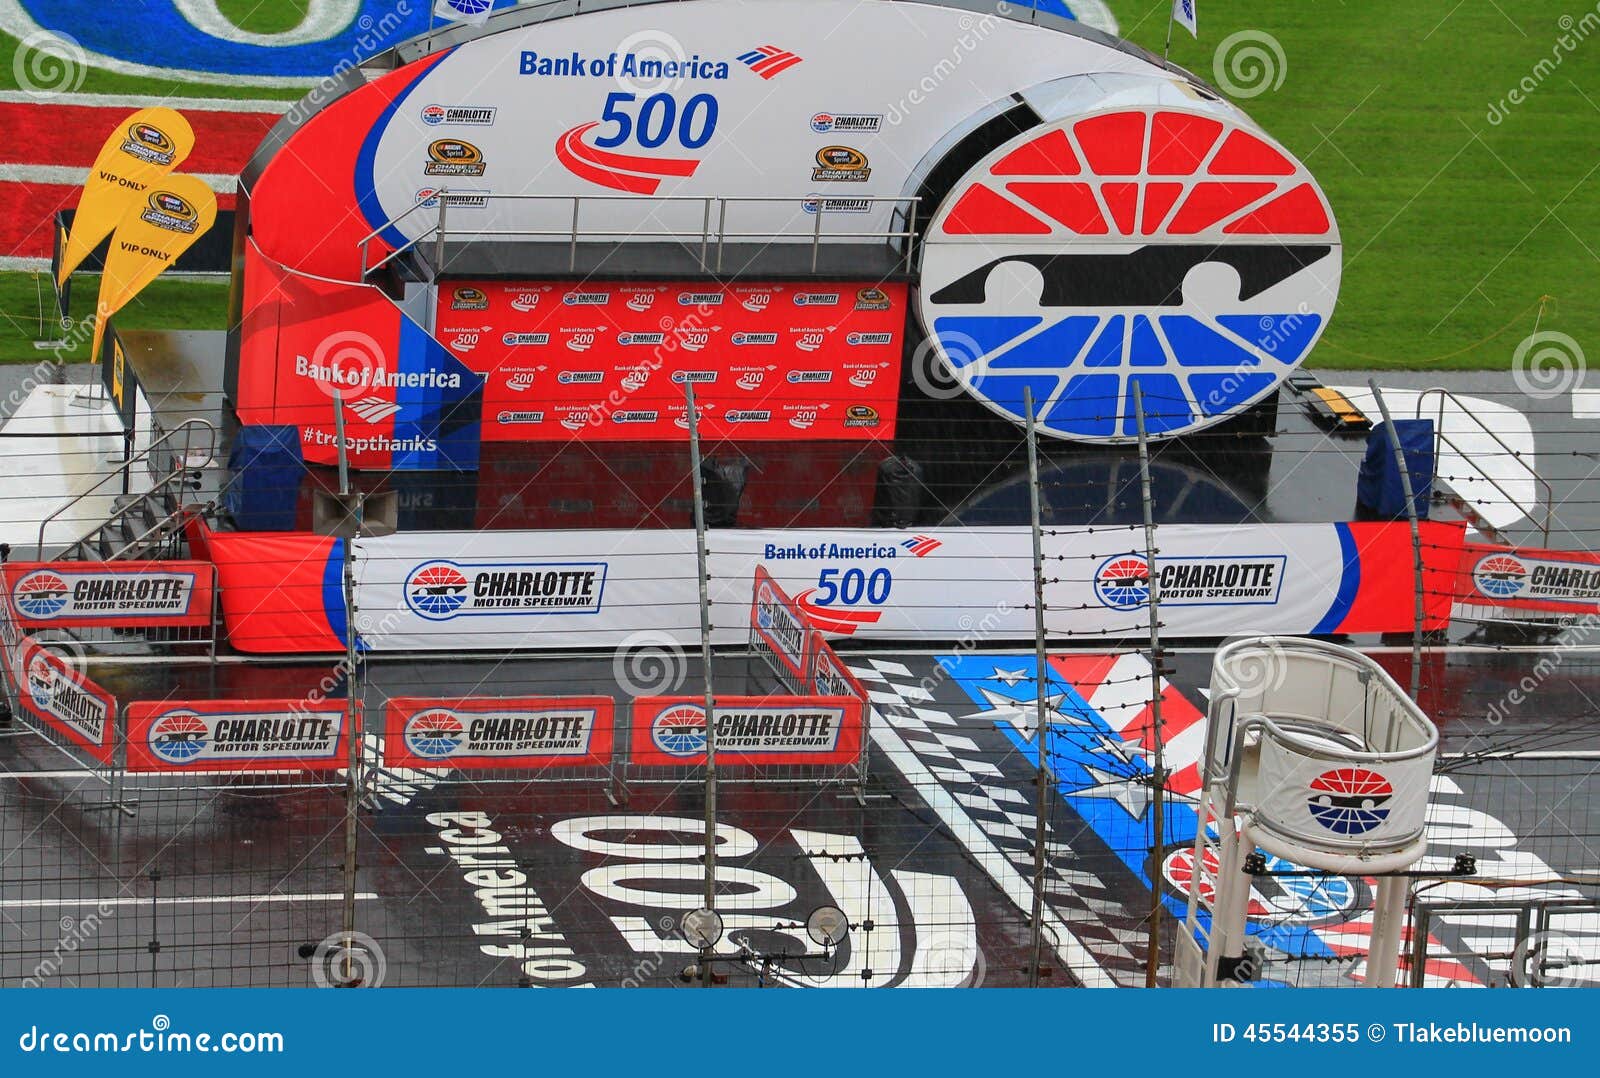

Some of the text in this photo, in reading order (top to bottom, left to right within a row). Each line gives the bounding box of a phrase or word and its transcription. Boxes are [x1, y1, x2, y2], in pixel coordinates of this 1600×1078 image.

[519, 50, 729, 80] Bank of America
[446, 108, 492, 119] CHARLOTTE
[594, 92, 719, 149] 500
[834, 116, 878, 126] CHARLOTTE
[100, 171, 148, 191] VIP ONLY
[120, 242, 171, 262] VIP ONLY
[519, 294, 540, 304] 500
[633, 294, 654, 304] 500
[750, 294, 770, 304] 500
[458, 333, 478, 344] 500
[573, 333, 594, 344] 500
[688, 333, 708, 344] 500
[803, 333, 824, 344] 500
[295, 355, 461, 388] Bank of America
[628, 372, 648, 382] 500
[742, 372, 763, 382] 500
[856, 369, 876, 380] 500
[513, 373, 534, 384] 500
[568, 411, 588, 422] 500
[796, 411, 817, 422] 500
[765, 542, 897, 560] Bank of America
[1159, 564, 1275, 588] CHARLOTTE
[73, 579, 184, 601] CHARLOTTE
[473, 572, 595, 597] CHARLOTTE
[814, 568, 892, 606] 500
[1159, 588, 1204, 598] MOTOR
[1530, 586, 1570, 596] MOTOR
[73, 602, 116, 610] MOTOR
[473, 598, 520, 608] MOTOR
[54, 678, 102, 729] CHARLOTTE
[214, 719, 332, 742] CHARLOTTE
[468, 717, 584, 741] CHARLOTTE
[716, 714, 832, 737] CHARLOTTE
[214, 743, 259, 752] MOTOR
[468, 742, 513, 750] MOTOR
[716, 738, 760, 746] MOTOR
[424, 811, 566, 940] America
[480, 944, 586, 979] of
